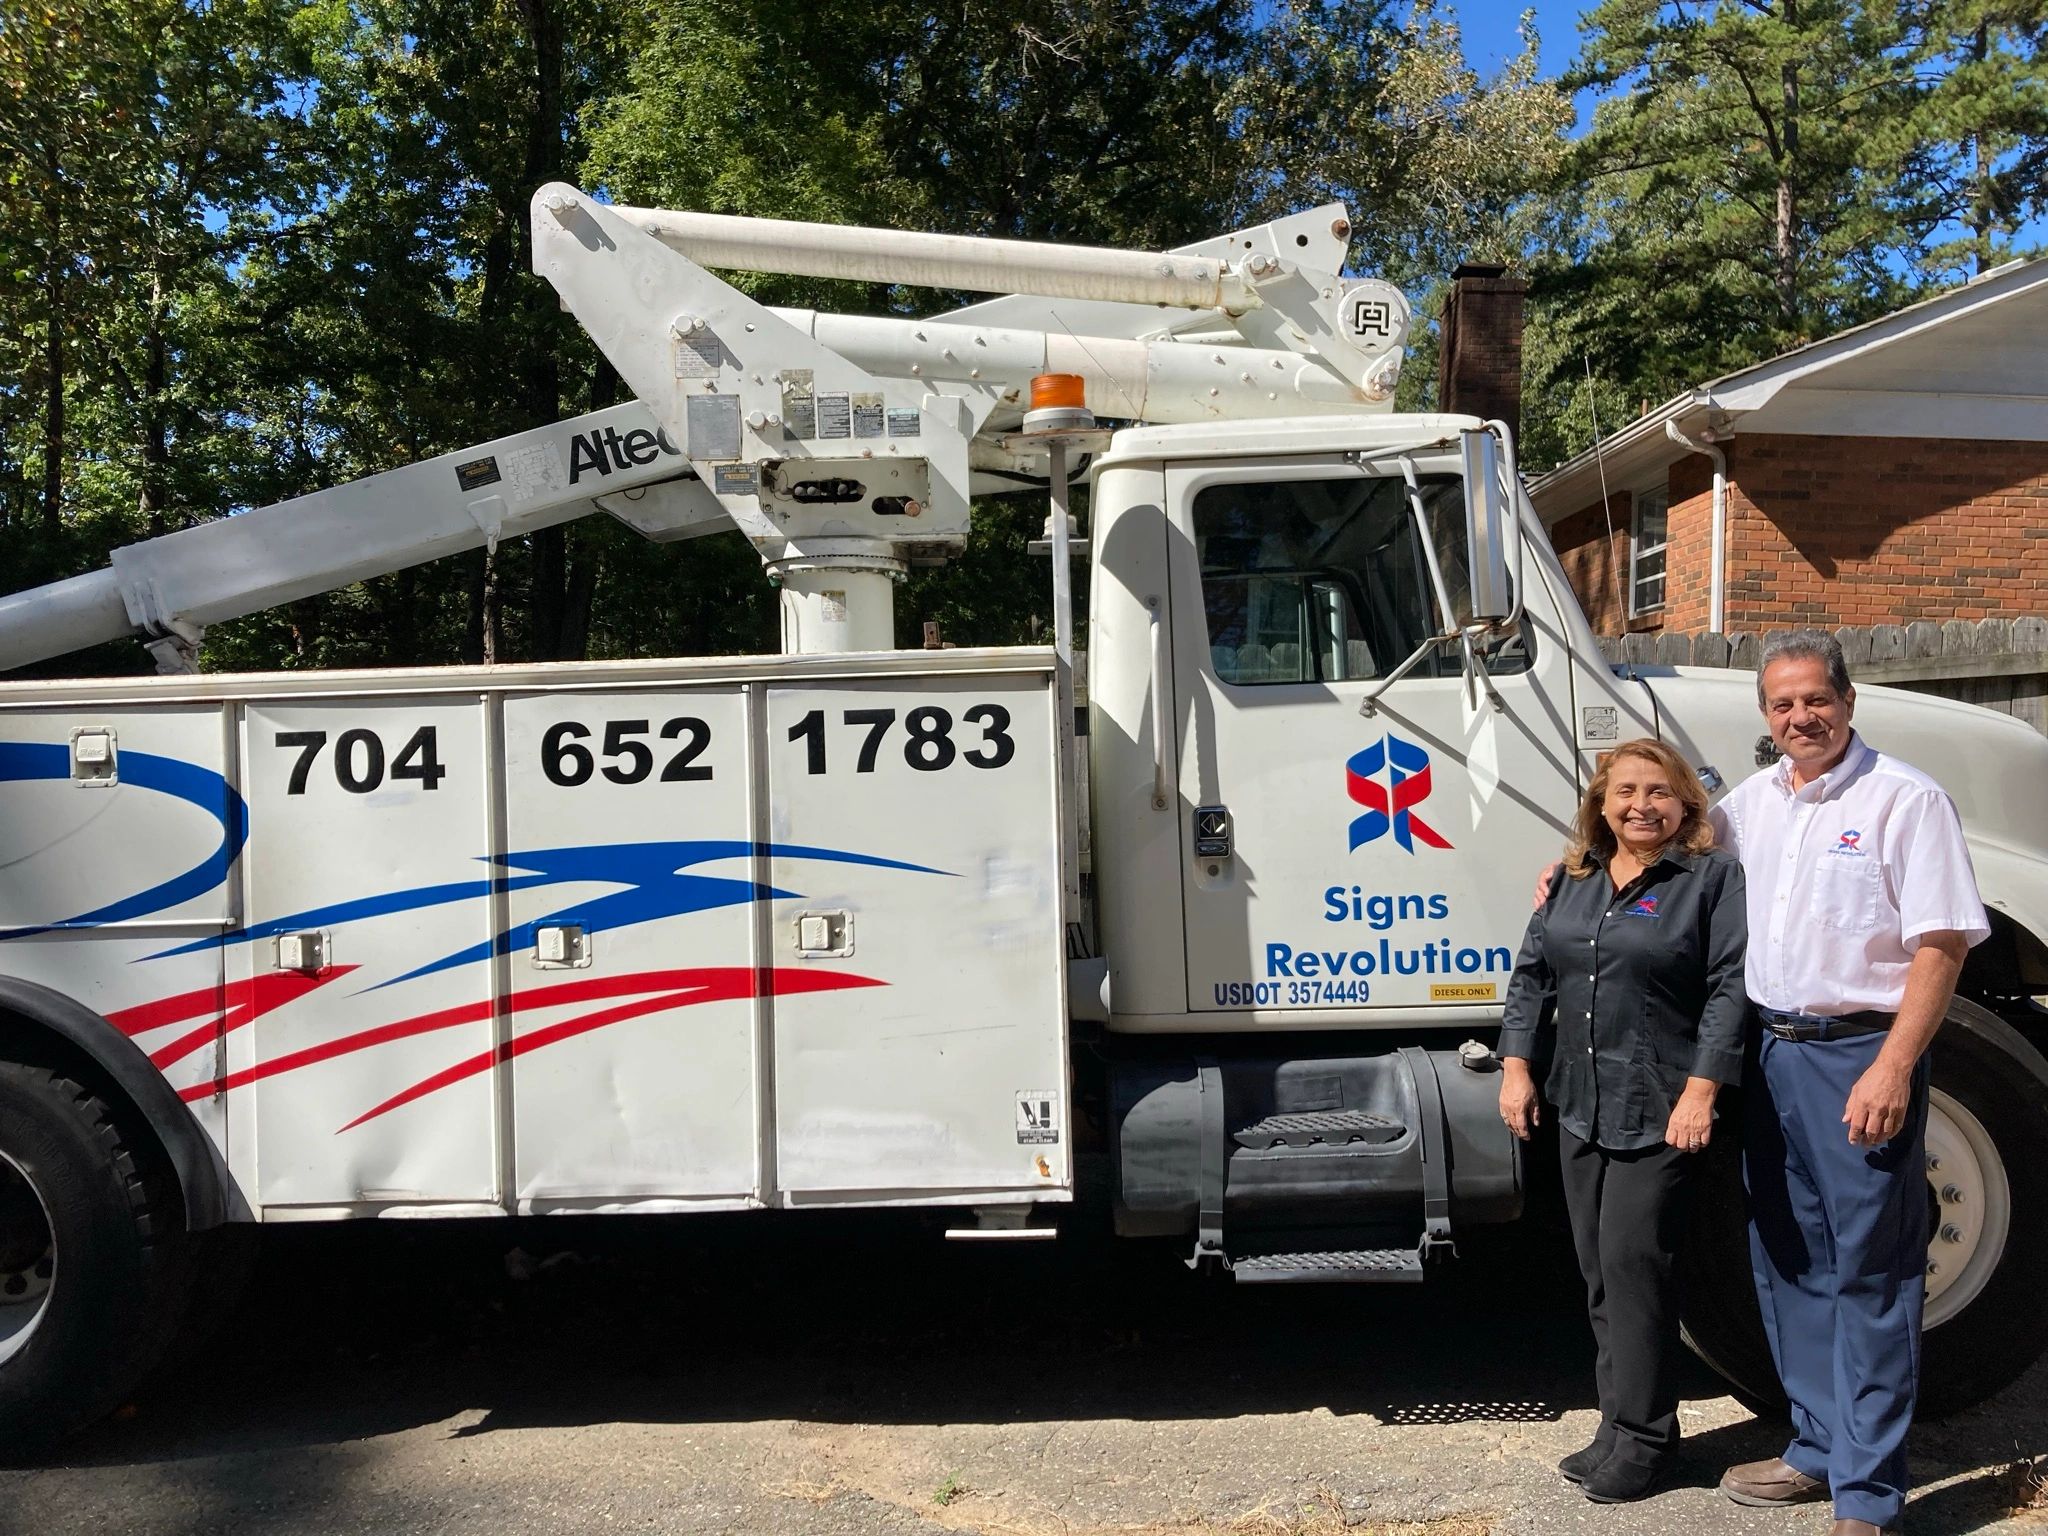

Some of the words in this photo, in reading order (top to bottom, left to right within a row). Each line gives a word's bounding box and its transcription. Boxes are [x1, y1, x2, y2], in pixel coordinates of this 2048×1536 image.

[275, 726, 446, 795] 704
[541, 717, 714, 787] 652
[788, 704, 1015, 775] 1783
[1324, 886, 1449, 930] Signs
[1266, 938, 1511, 977] Revolution
[1214, 982, 1281, 1005] USDOT
[1288, 981, 1369, 1003] 3574449
[1434, 988, 1465, 996] DIESEL
[1467, 987, 1491, 996] ONLY
